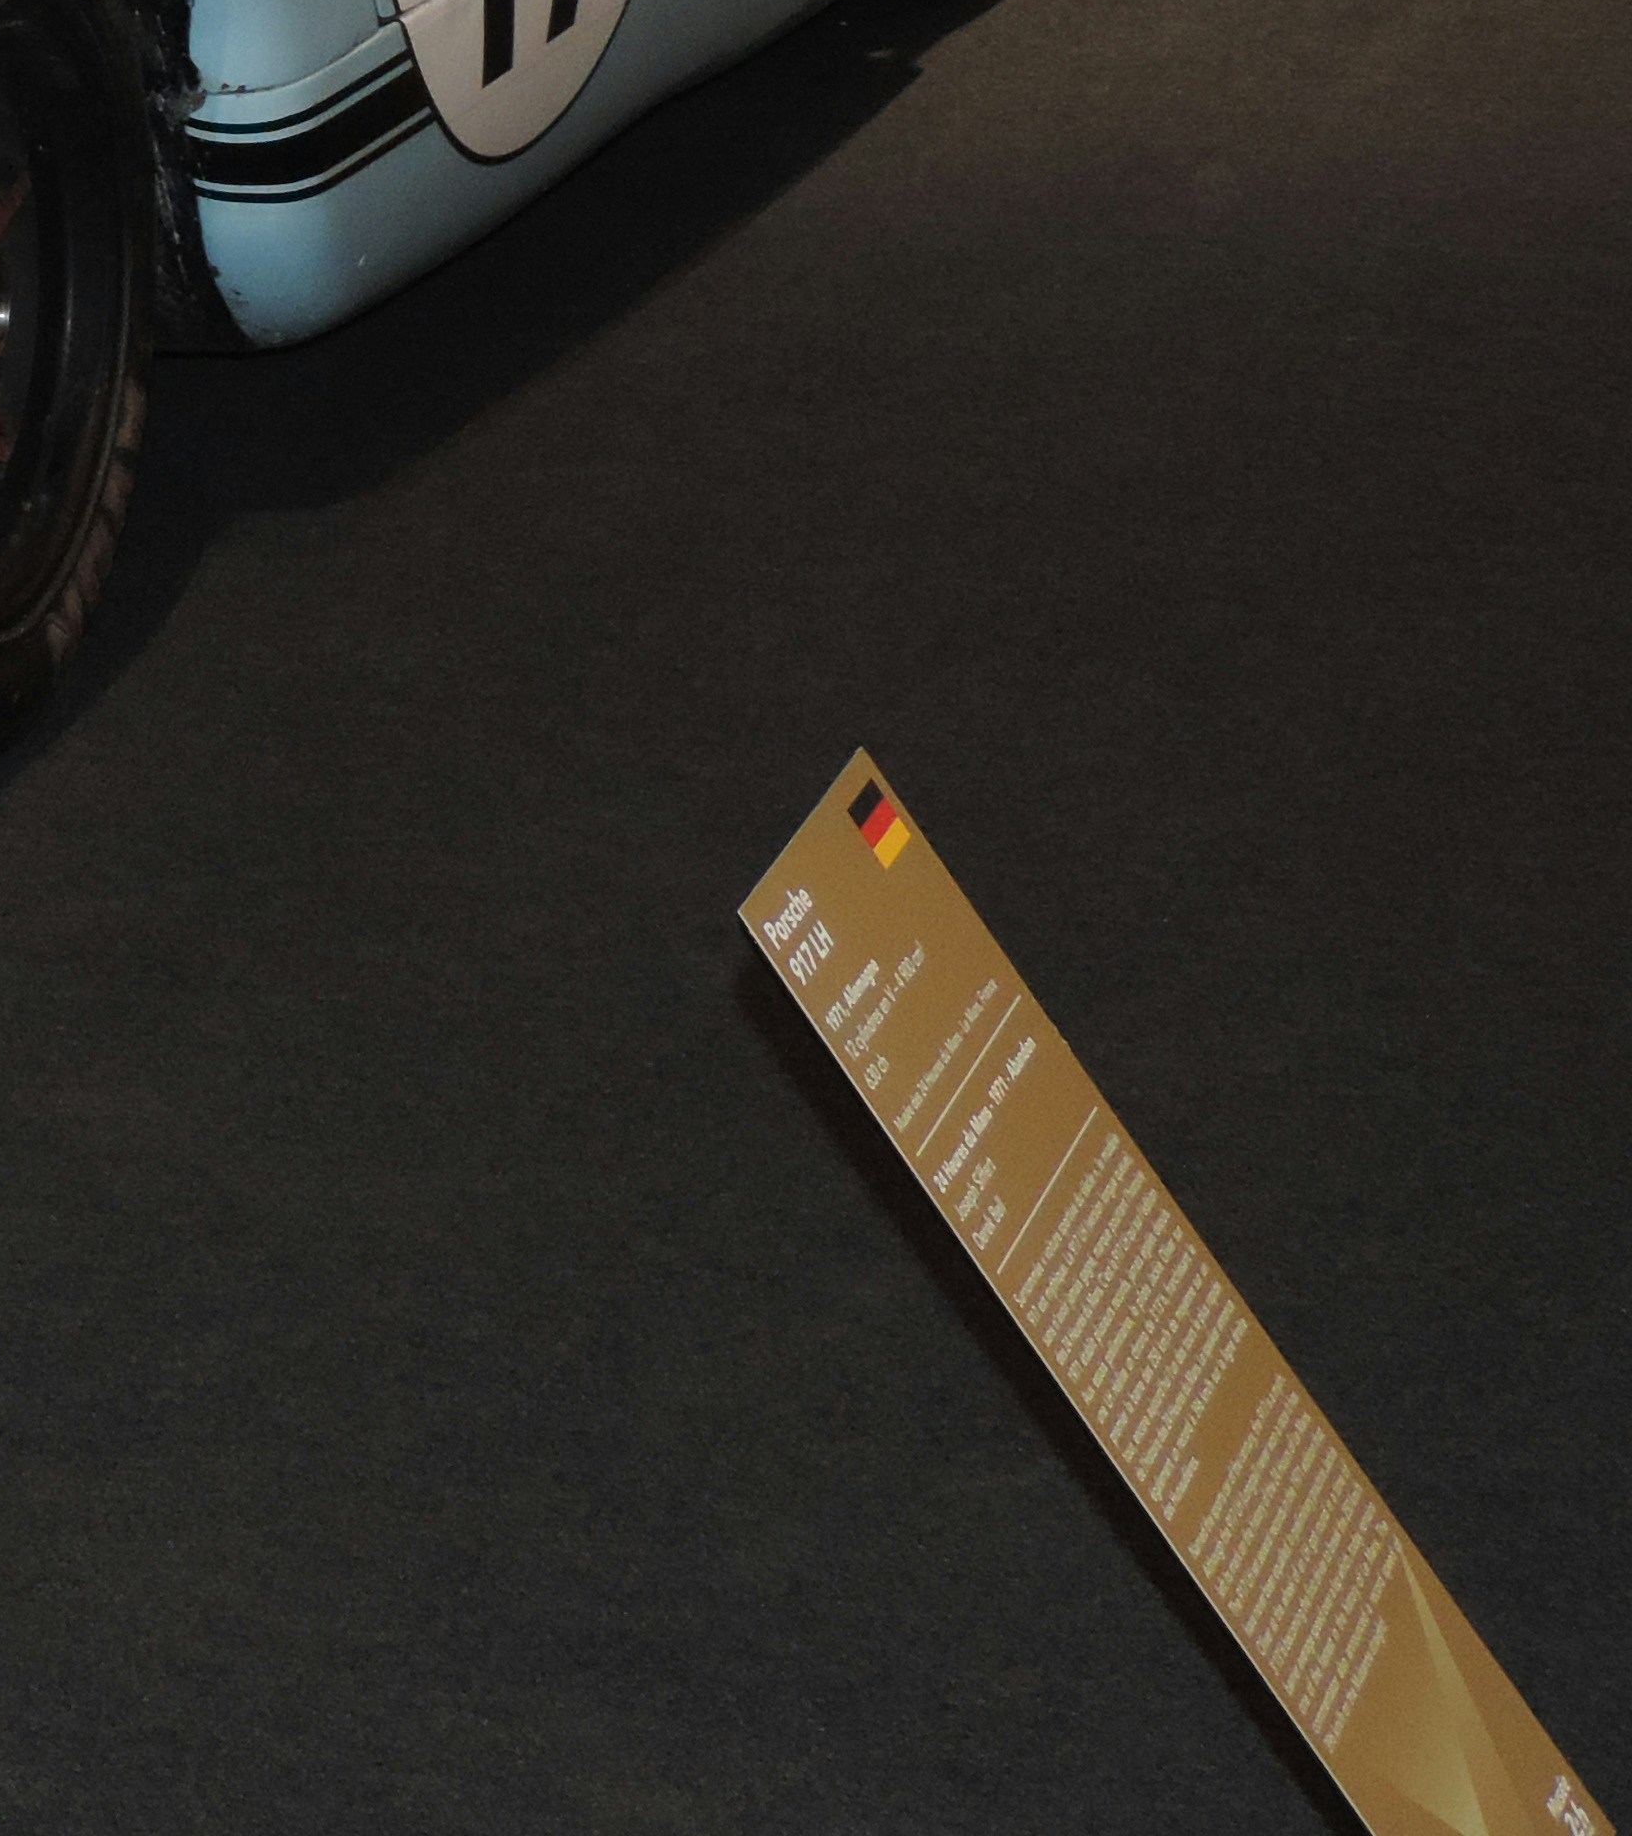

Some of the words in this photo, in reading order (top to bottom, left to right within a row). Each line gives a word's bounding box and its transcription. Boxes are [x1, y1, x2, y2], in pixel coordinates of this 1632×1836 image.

[763, 888, 813, 951] Porsche
[789, 940, 817, 986] 917
[808, 920, 834, 959] LH
[825, 1000, 851, 1031] 1971,
[842, 958, 879, 1008] Allemagne
[844, 1039, 861, 1061] 12
[933, 1169, 949, 1195] 24
[941, 1143, 970, 1181] Heures
[962, 1129, 978, 1150] du
[988, 1075, 1010, 1107] 1971
